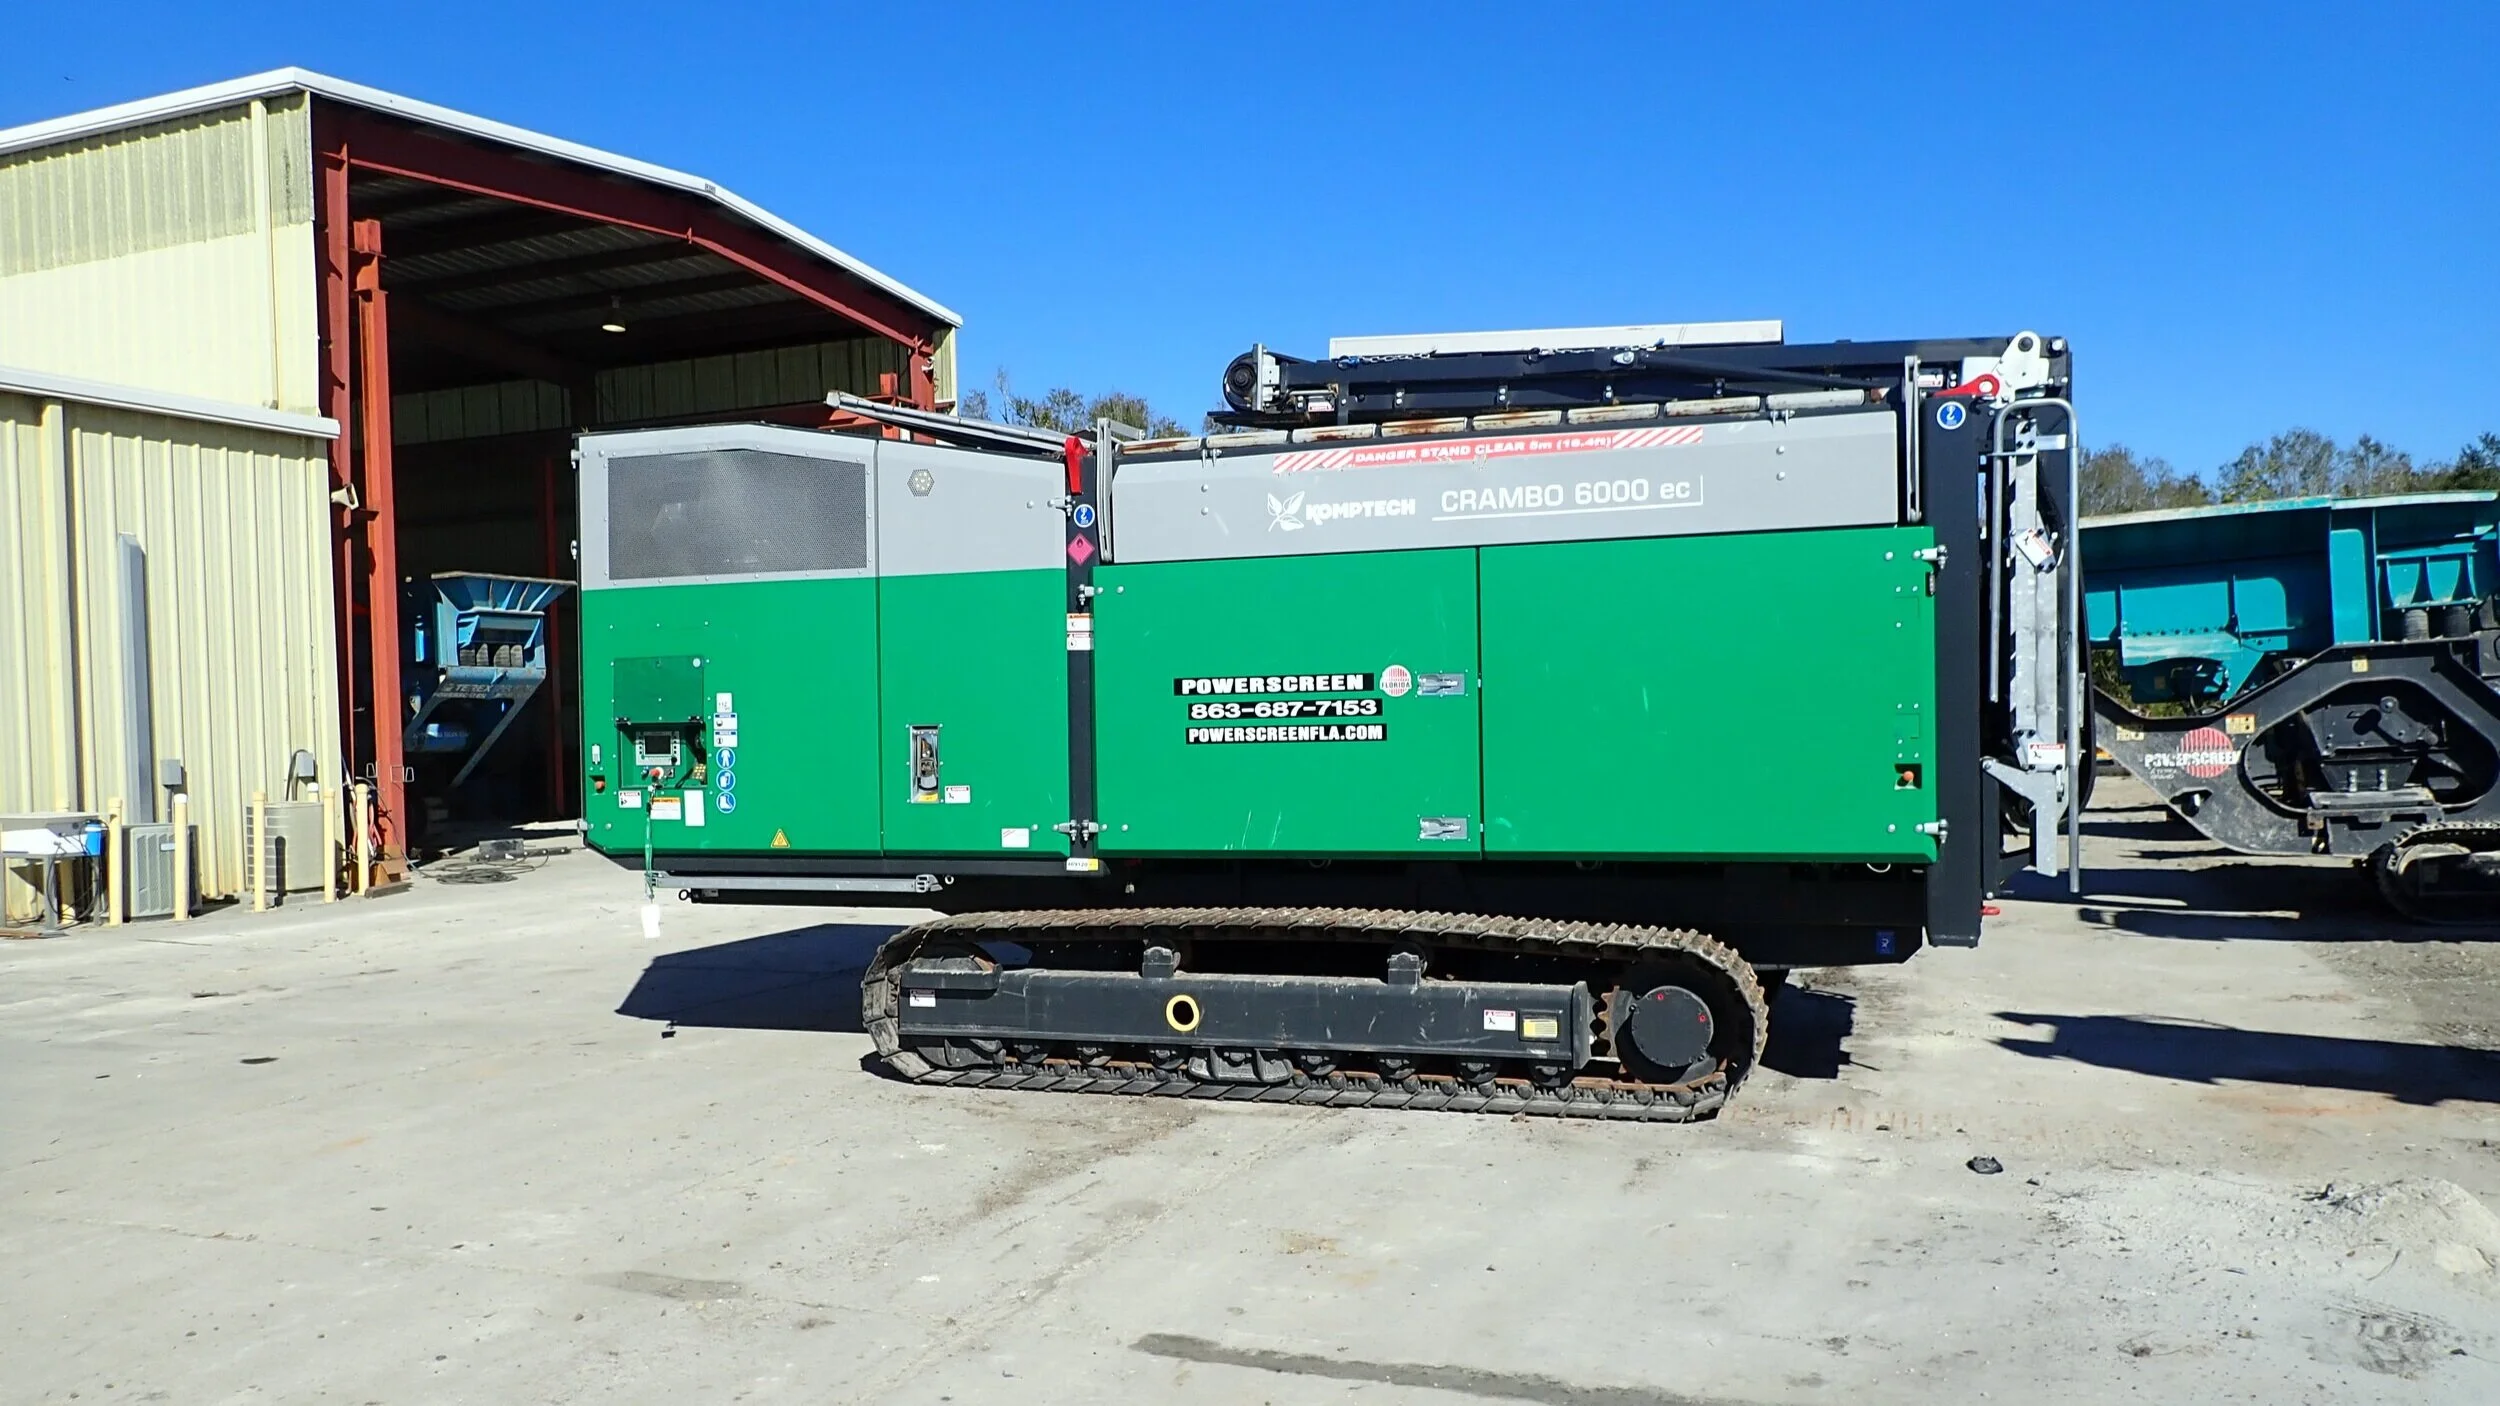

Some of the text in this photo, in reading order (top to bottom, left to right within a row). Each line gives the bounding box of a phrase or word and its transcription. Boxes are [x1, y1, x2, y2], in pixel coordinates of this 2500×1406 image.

[1355, 449, 1416, 463] DANGER
[1421, 446, 1470, 459] STAND
[1475, 442, 1524, 456] CLEAR
[1440, 478, 1691, 513] CRAMBO 6000 ec
[1305, 497, 1416, 526] KOMPTECH
[1181, 674, 1364, 695] POWERSCREEN
[1381, 681, 1410, 689] FLORIDA
[1190, 699, 1378, 720] 863-687-7153
[1188, 725, 1383, 743] POWERSCREENFLA.COM
